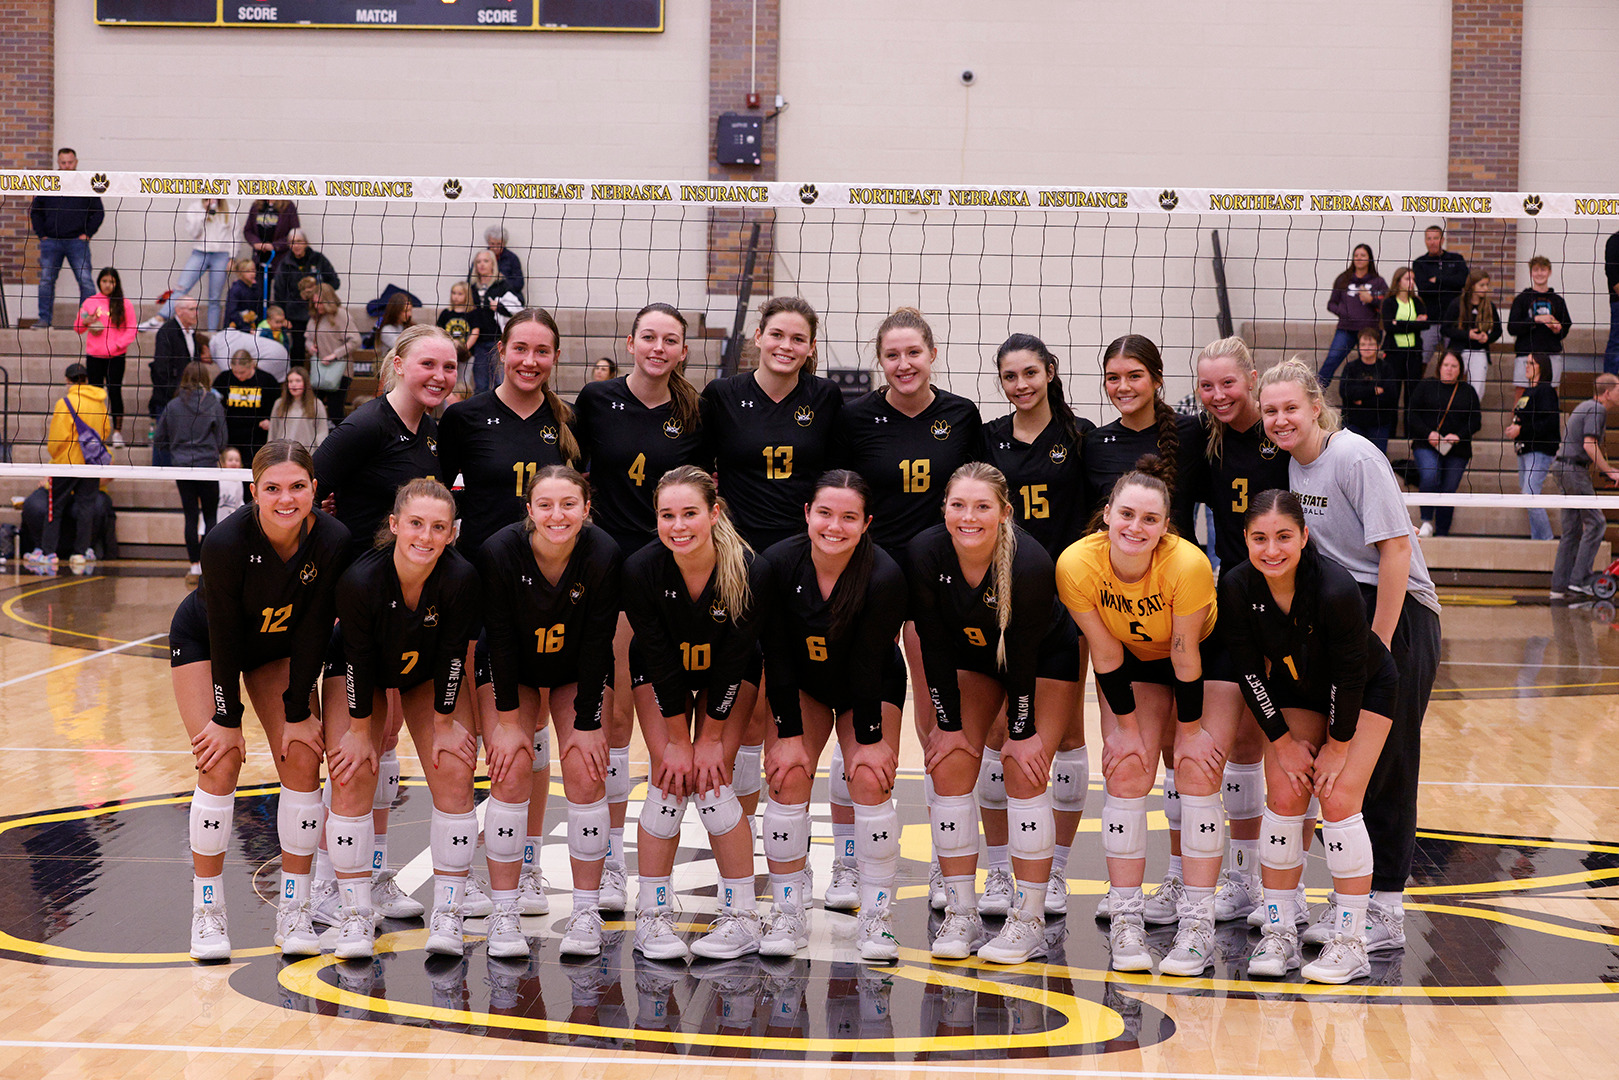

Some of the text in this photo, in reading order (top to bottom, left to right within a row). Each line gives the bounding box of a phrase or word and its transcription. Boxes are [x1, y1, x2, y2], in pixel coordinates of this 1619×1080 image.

[238, 7, 278, 21] SCORE
[355, 9, 397, 23] MATCH
[477, 10, 518, 23] SCORE
[140, 178, 413, 198] NORTHEAST NEBRASKA INSURANCE
[493, 183, 768, 202] NORTHEAST NEBRASKA INSURANCE
[849, 188, 1128, 208] NORTHEAST NEBRASKA INSURANCE
[1210, 194, 1492, 213] NORTHEAST NEBRASKA INSURANCE
[1575, 199, 1619, 215] NORT
[628, 452, 646, 487] 4
[762, 446, 793, 480] 13
[898, 458, 931, 493] 18
[1019, 483, 1050, 519] 15
[1231, 478, 1248, 513] 3
[1302, 494, 1328, 507] STATE
[1100, 589, 1135, 616] WAYNE
[260, 604, 293, 633] 12
[534, 623, 565, 653] 16
[963, 627, 988, 647] 9
[1129, 621, 1153, 642] 5
[679, 642, 711, 671] 10
[806, 636, 828, 662] 6
[400, 651, 420, 675] 7
[1282, 655, 1299, 680] 1
[346, 662, 357, 709] WILDCATS
[443, 681, 458, 705] STATE
